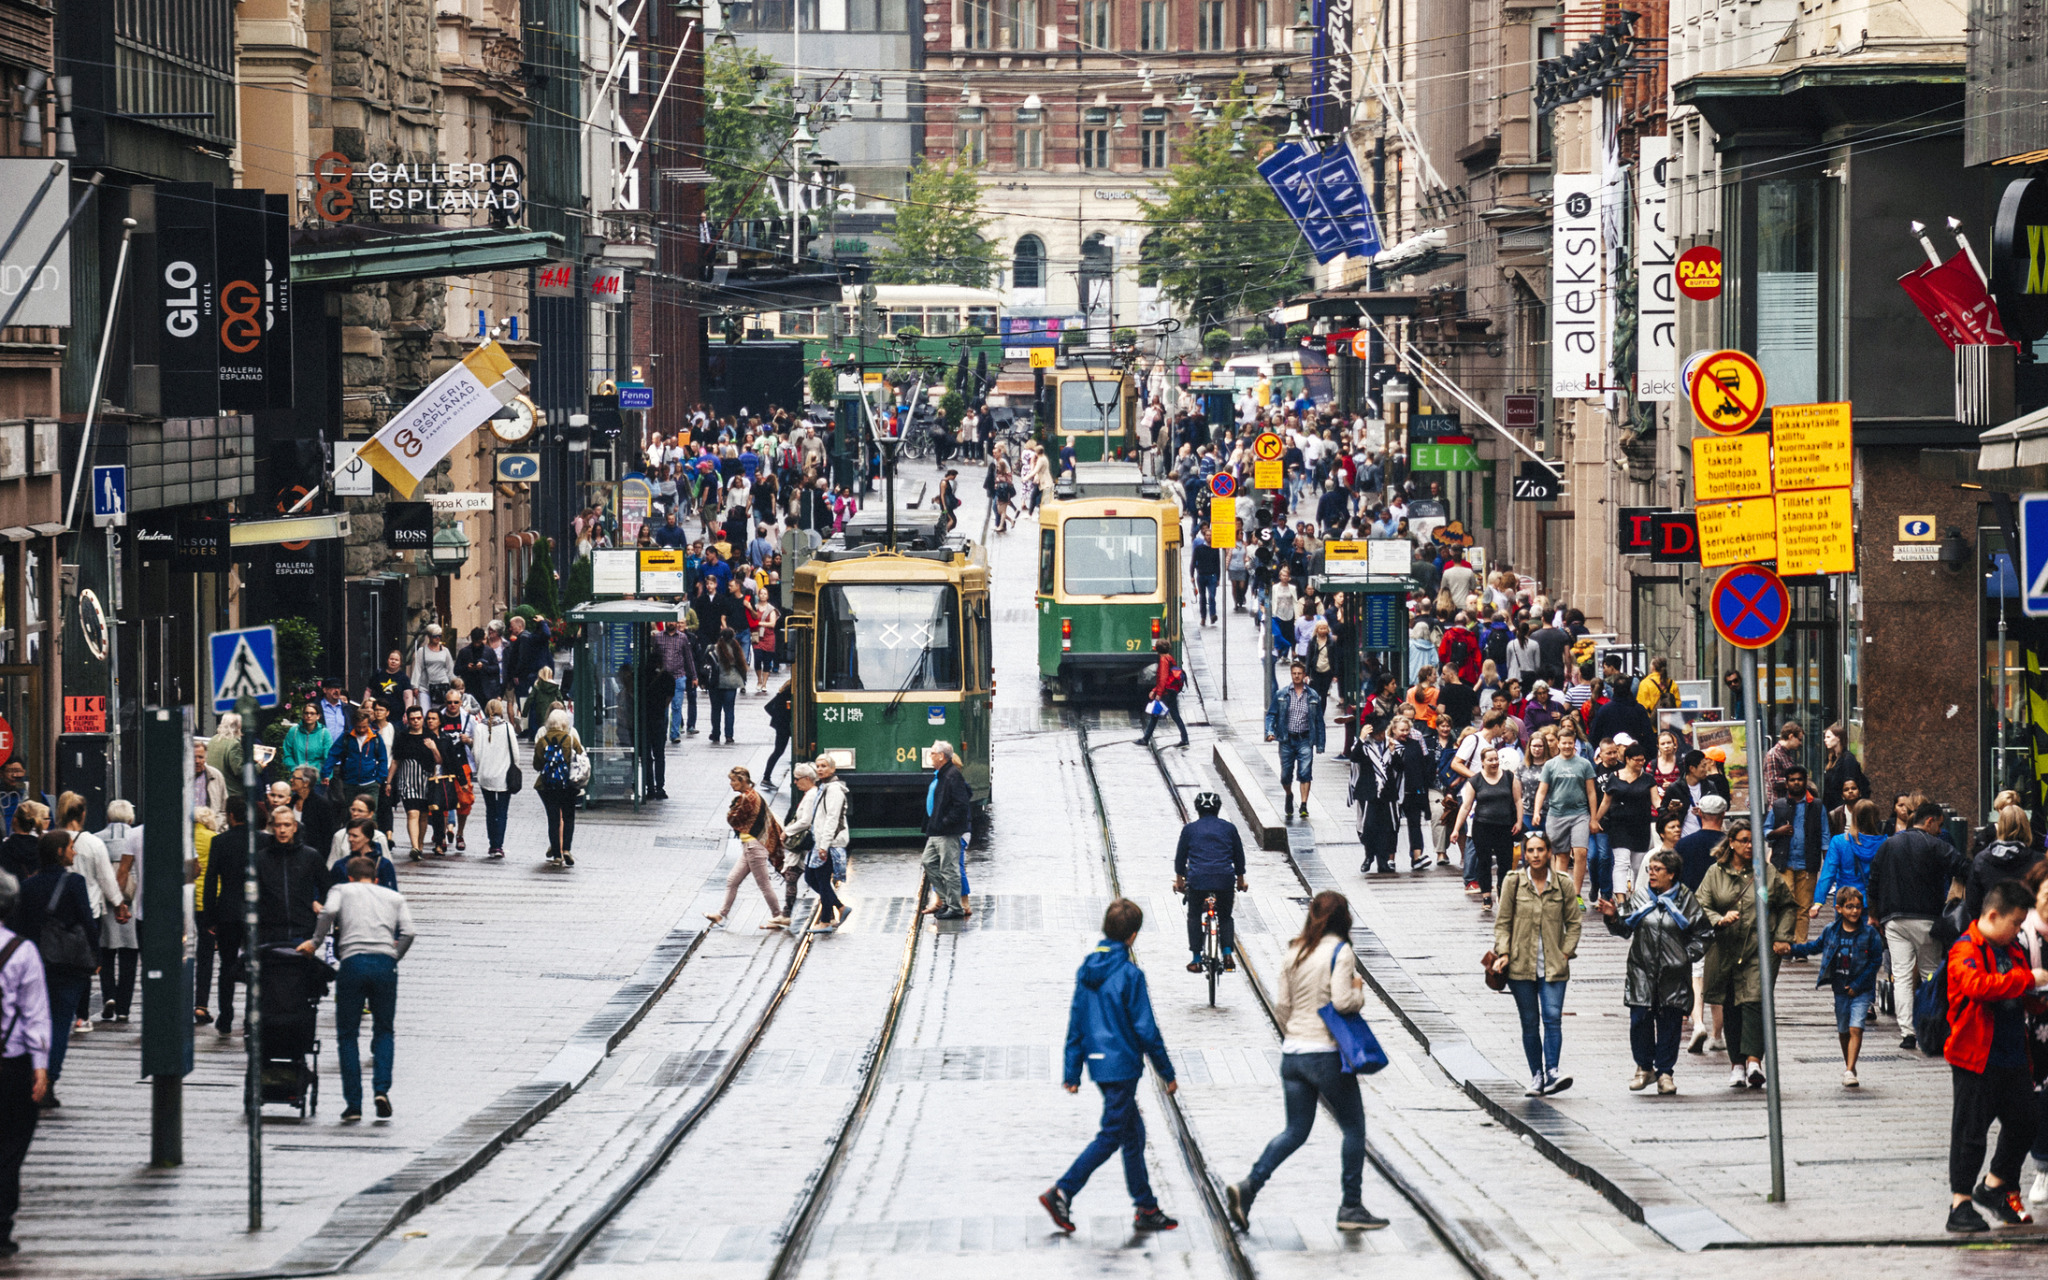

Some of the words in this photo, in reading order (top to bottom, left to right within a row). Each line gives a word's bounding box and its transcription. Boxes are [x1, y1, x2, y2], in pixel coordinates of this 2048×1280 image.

[368, 162, 519, 183] GALLERIA
[369, 189, 520, 210] ESPLANAD
[763, 171, 856, 213] Aktia
[1095, 189, 1139, 201] Capacet
[539, 267, 571, 288] H&M
[1679, 260, 1722, 279] RAX
[280, 278, 288, 311] HOTEL
[592, 275, 620, 295] H&M
[1555, 227, 1597, 354] aleksi
[165, 261, 198, 338] GLO
[204, 282, 212, 315] HOTEL
[220, 366, 263, 374] GALLERIA
[622, 390, 650, 399] Fenno
[1555, 379, 1589, 392] aleks
[412, 379, 469, 428] GALLERIA
[418, 385, 476, 435] ESPLANAD
[1703, 443, 1712, 454] Ei
[1716, 442, 1743, 452] koske
[1515, 480, 1548, 498] Zio
[455, 498, 463, 508] K
[1782, 511, 1813, 521] stanna
[395, 530, 427, 540] BOSS
[1126, 639, 1142, 651] 97
[896, 747, 917, 763] 84
